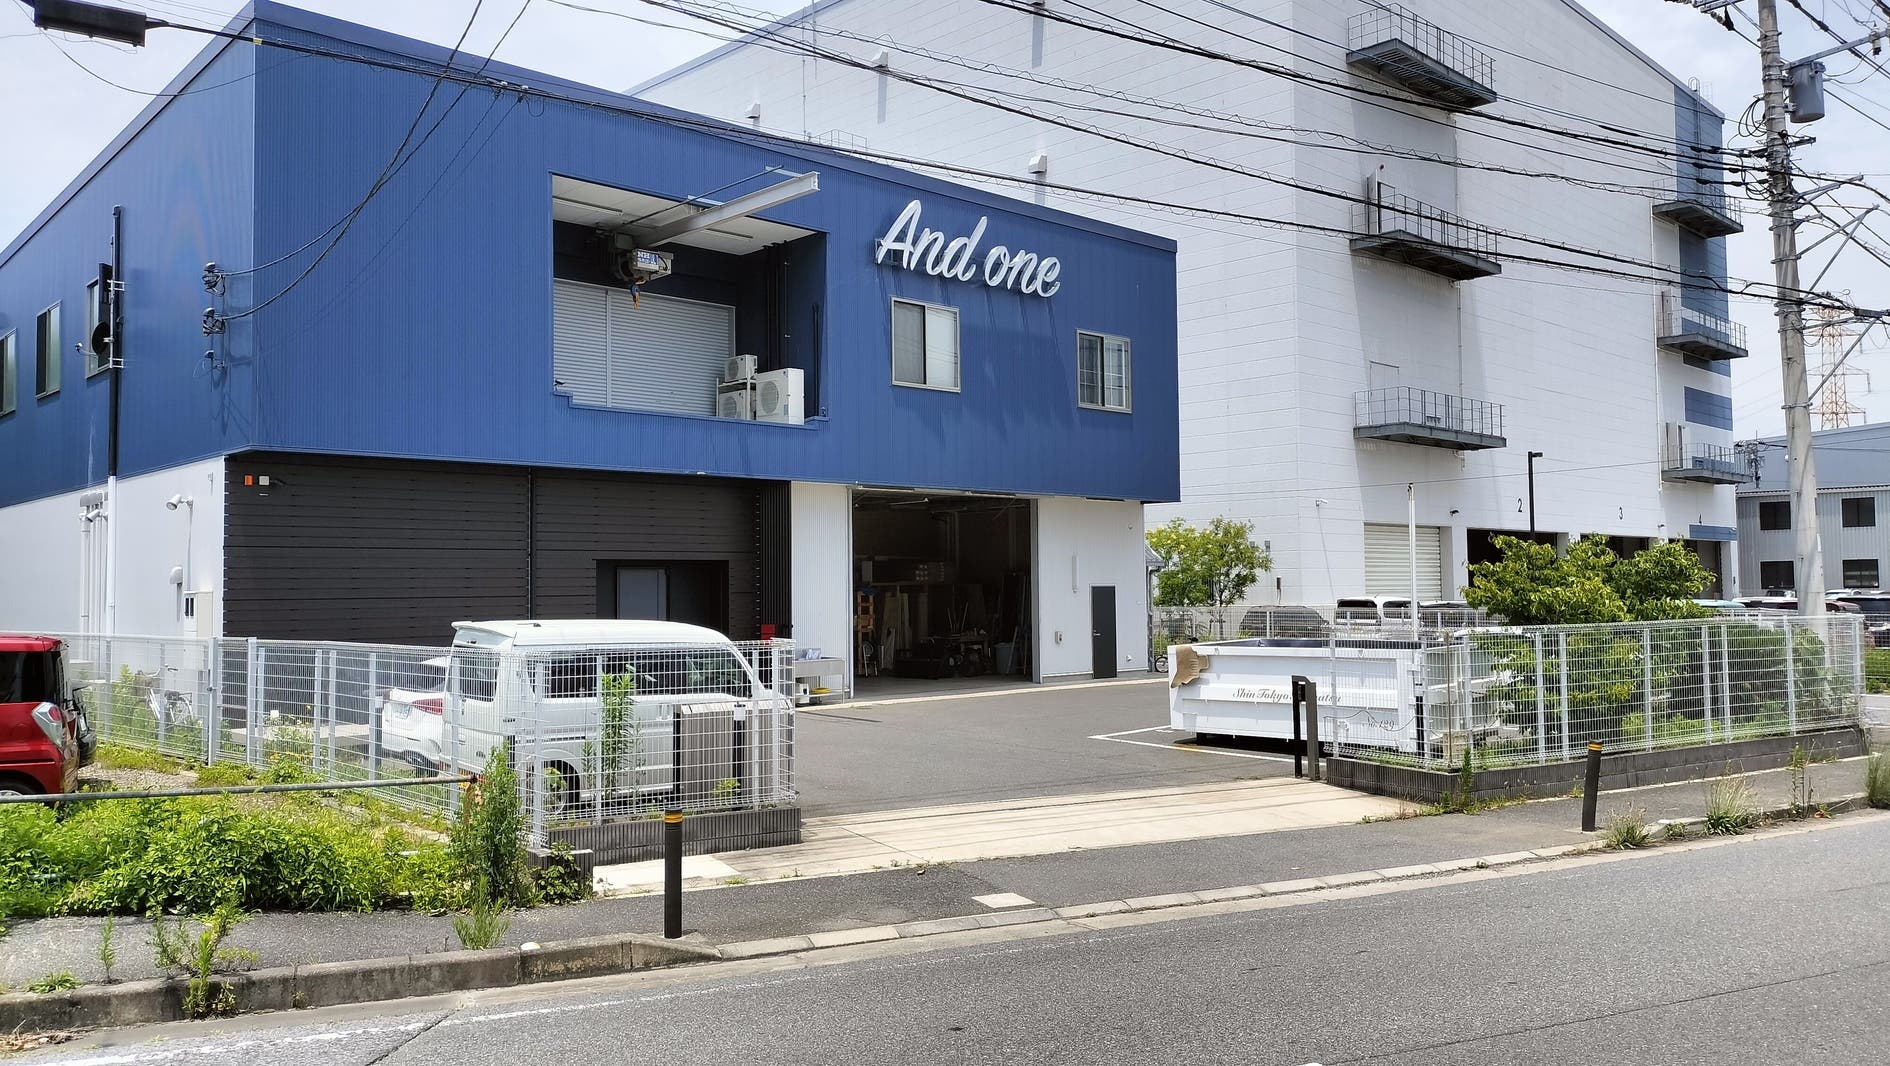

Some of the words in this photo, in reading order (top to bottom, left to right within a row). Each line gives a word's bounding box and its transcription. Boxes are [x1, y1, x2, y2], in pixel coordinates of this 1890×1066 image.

[876, 199, 988, 282] And
[984, 245, 1061, 298] one
[1517, 498, 1523, 513] 2
[1618, 506, 1624, 520] 3
